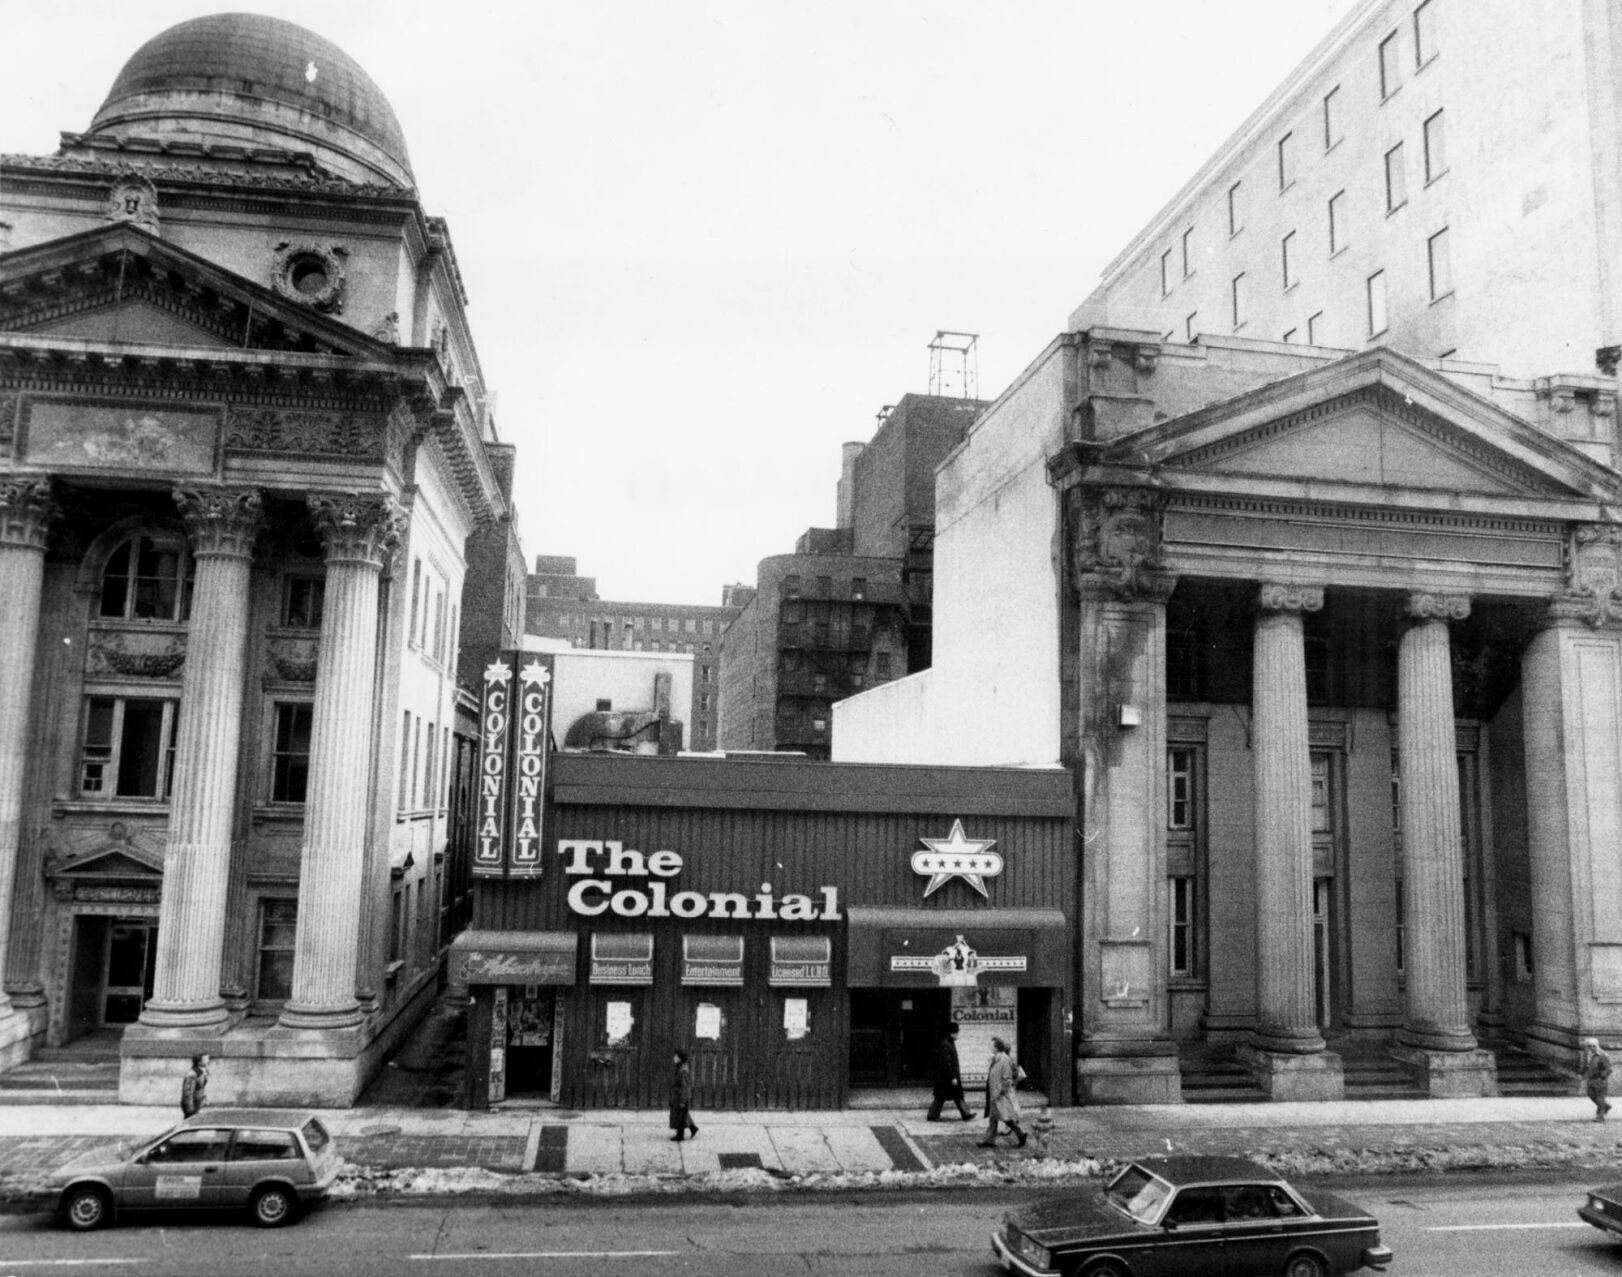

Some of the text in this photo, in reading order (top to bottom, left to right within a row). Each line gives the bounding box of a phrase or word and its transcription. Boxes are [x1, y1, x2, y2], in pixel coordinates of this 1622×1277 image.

[480, 691, 504, 858] COLONIAL
[518, 693, 542, 859] COLONIAL
[557, 839, 683, 877] The
[567, 879, 842, 921] Colonial
[592, 963, 651, 976] Business Lunch
[685, 964, 741, 977] Entertainment
[772, 965, 804, 978] Licensed
[953, 1009, 1015, 1021] Colonial
